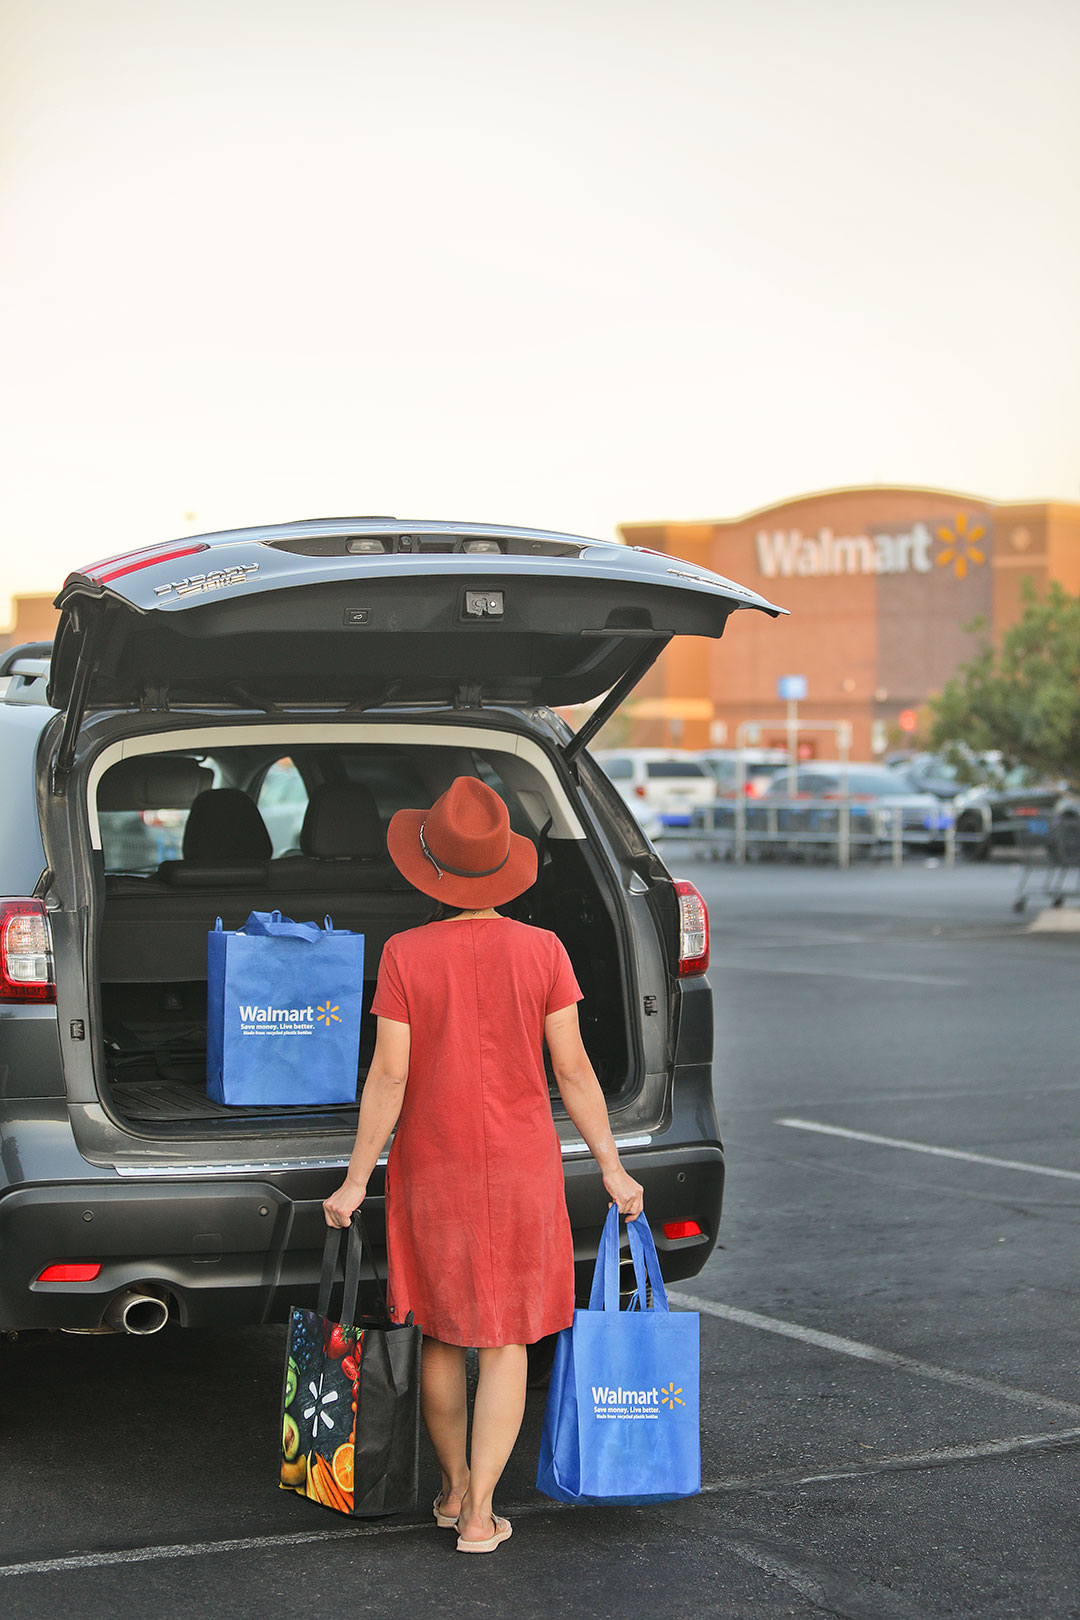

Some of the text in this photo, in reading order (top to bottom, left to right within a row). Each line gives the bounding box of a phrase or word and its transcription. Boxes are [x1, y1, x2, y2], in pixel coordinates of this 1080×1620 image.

[755, 522, 932, 578] Walmart
[239, 1006, 313, 1022] Walmart
[592, 1387, 658, 1404] Walmart
